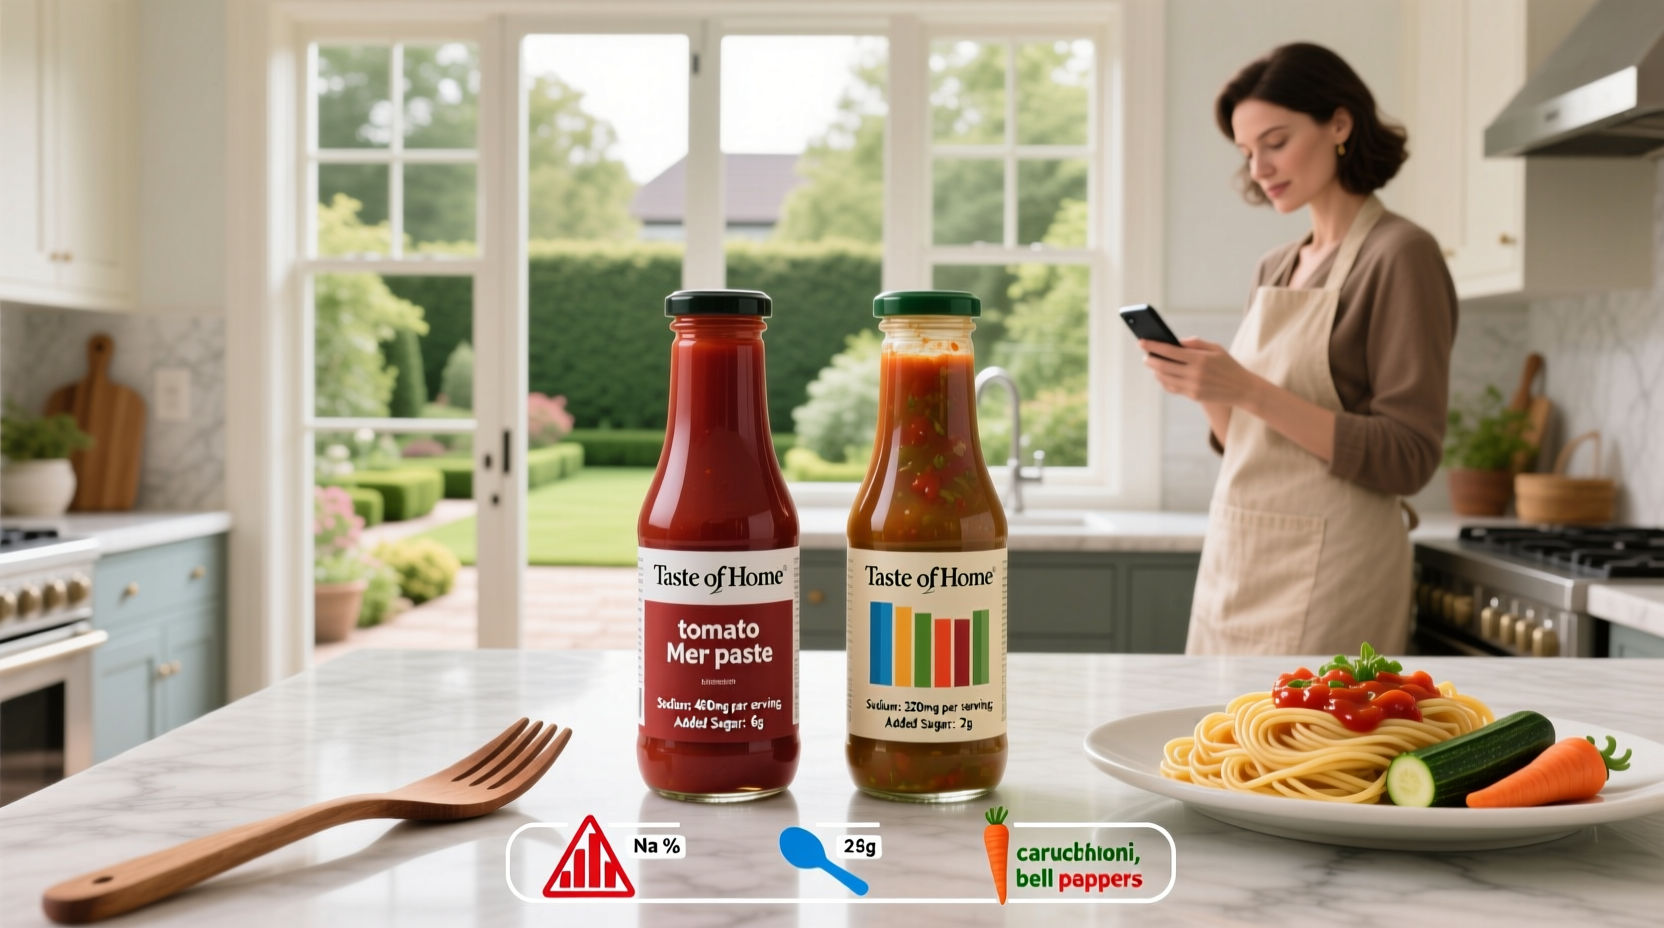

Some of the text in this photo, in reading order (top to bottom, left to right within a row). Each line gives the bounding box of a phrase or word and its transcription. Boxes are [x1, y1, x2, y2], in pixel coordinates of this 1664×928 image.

[653, 564, 784, 595] Taste of Home
[865, 565, 994, 594] Taste of Home
[677, 619, 760, 640] tomato
[666, 642, 773, 670] Mer paste
[941, 703, 959, 716] per
[959, 717, 973, 731] 2g
